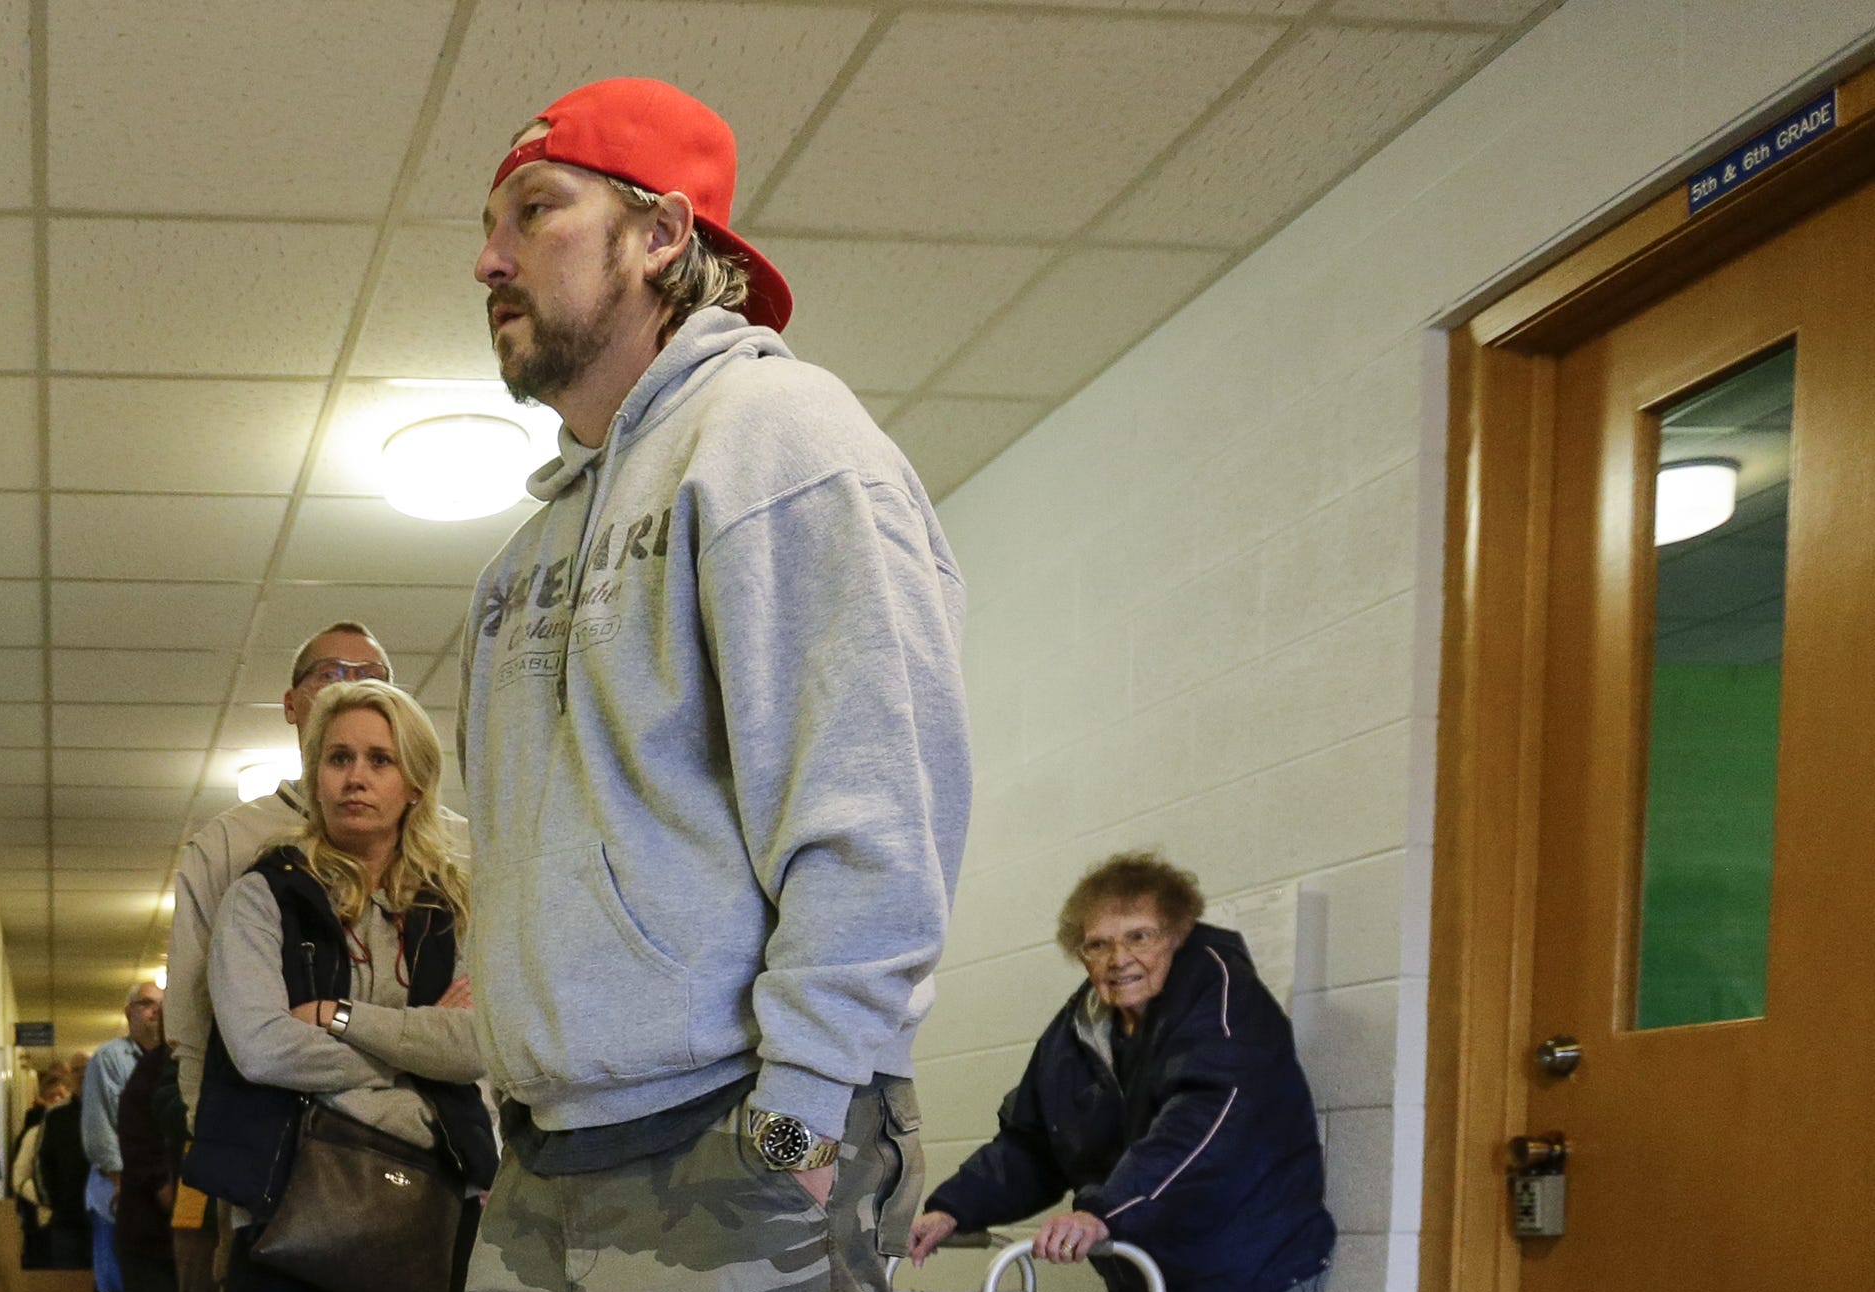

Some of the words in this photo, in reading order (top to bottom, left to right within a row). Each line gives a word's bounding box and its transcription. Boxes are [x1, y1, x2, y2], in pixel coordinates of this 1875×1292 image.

[1691, 176, 1718, 203] 5th
[1723, 163, 1737, 183] &
[1742, 143, 1770, 171] 6th
[1776, 102, 1832, 150] GRADE
